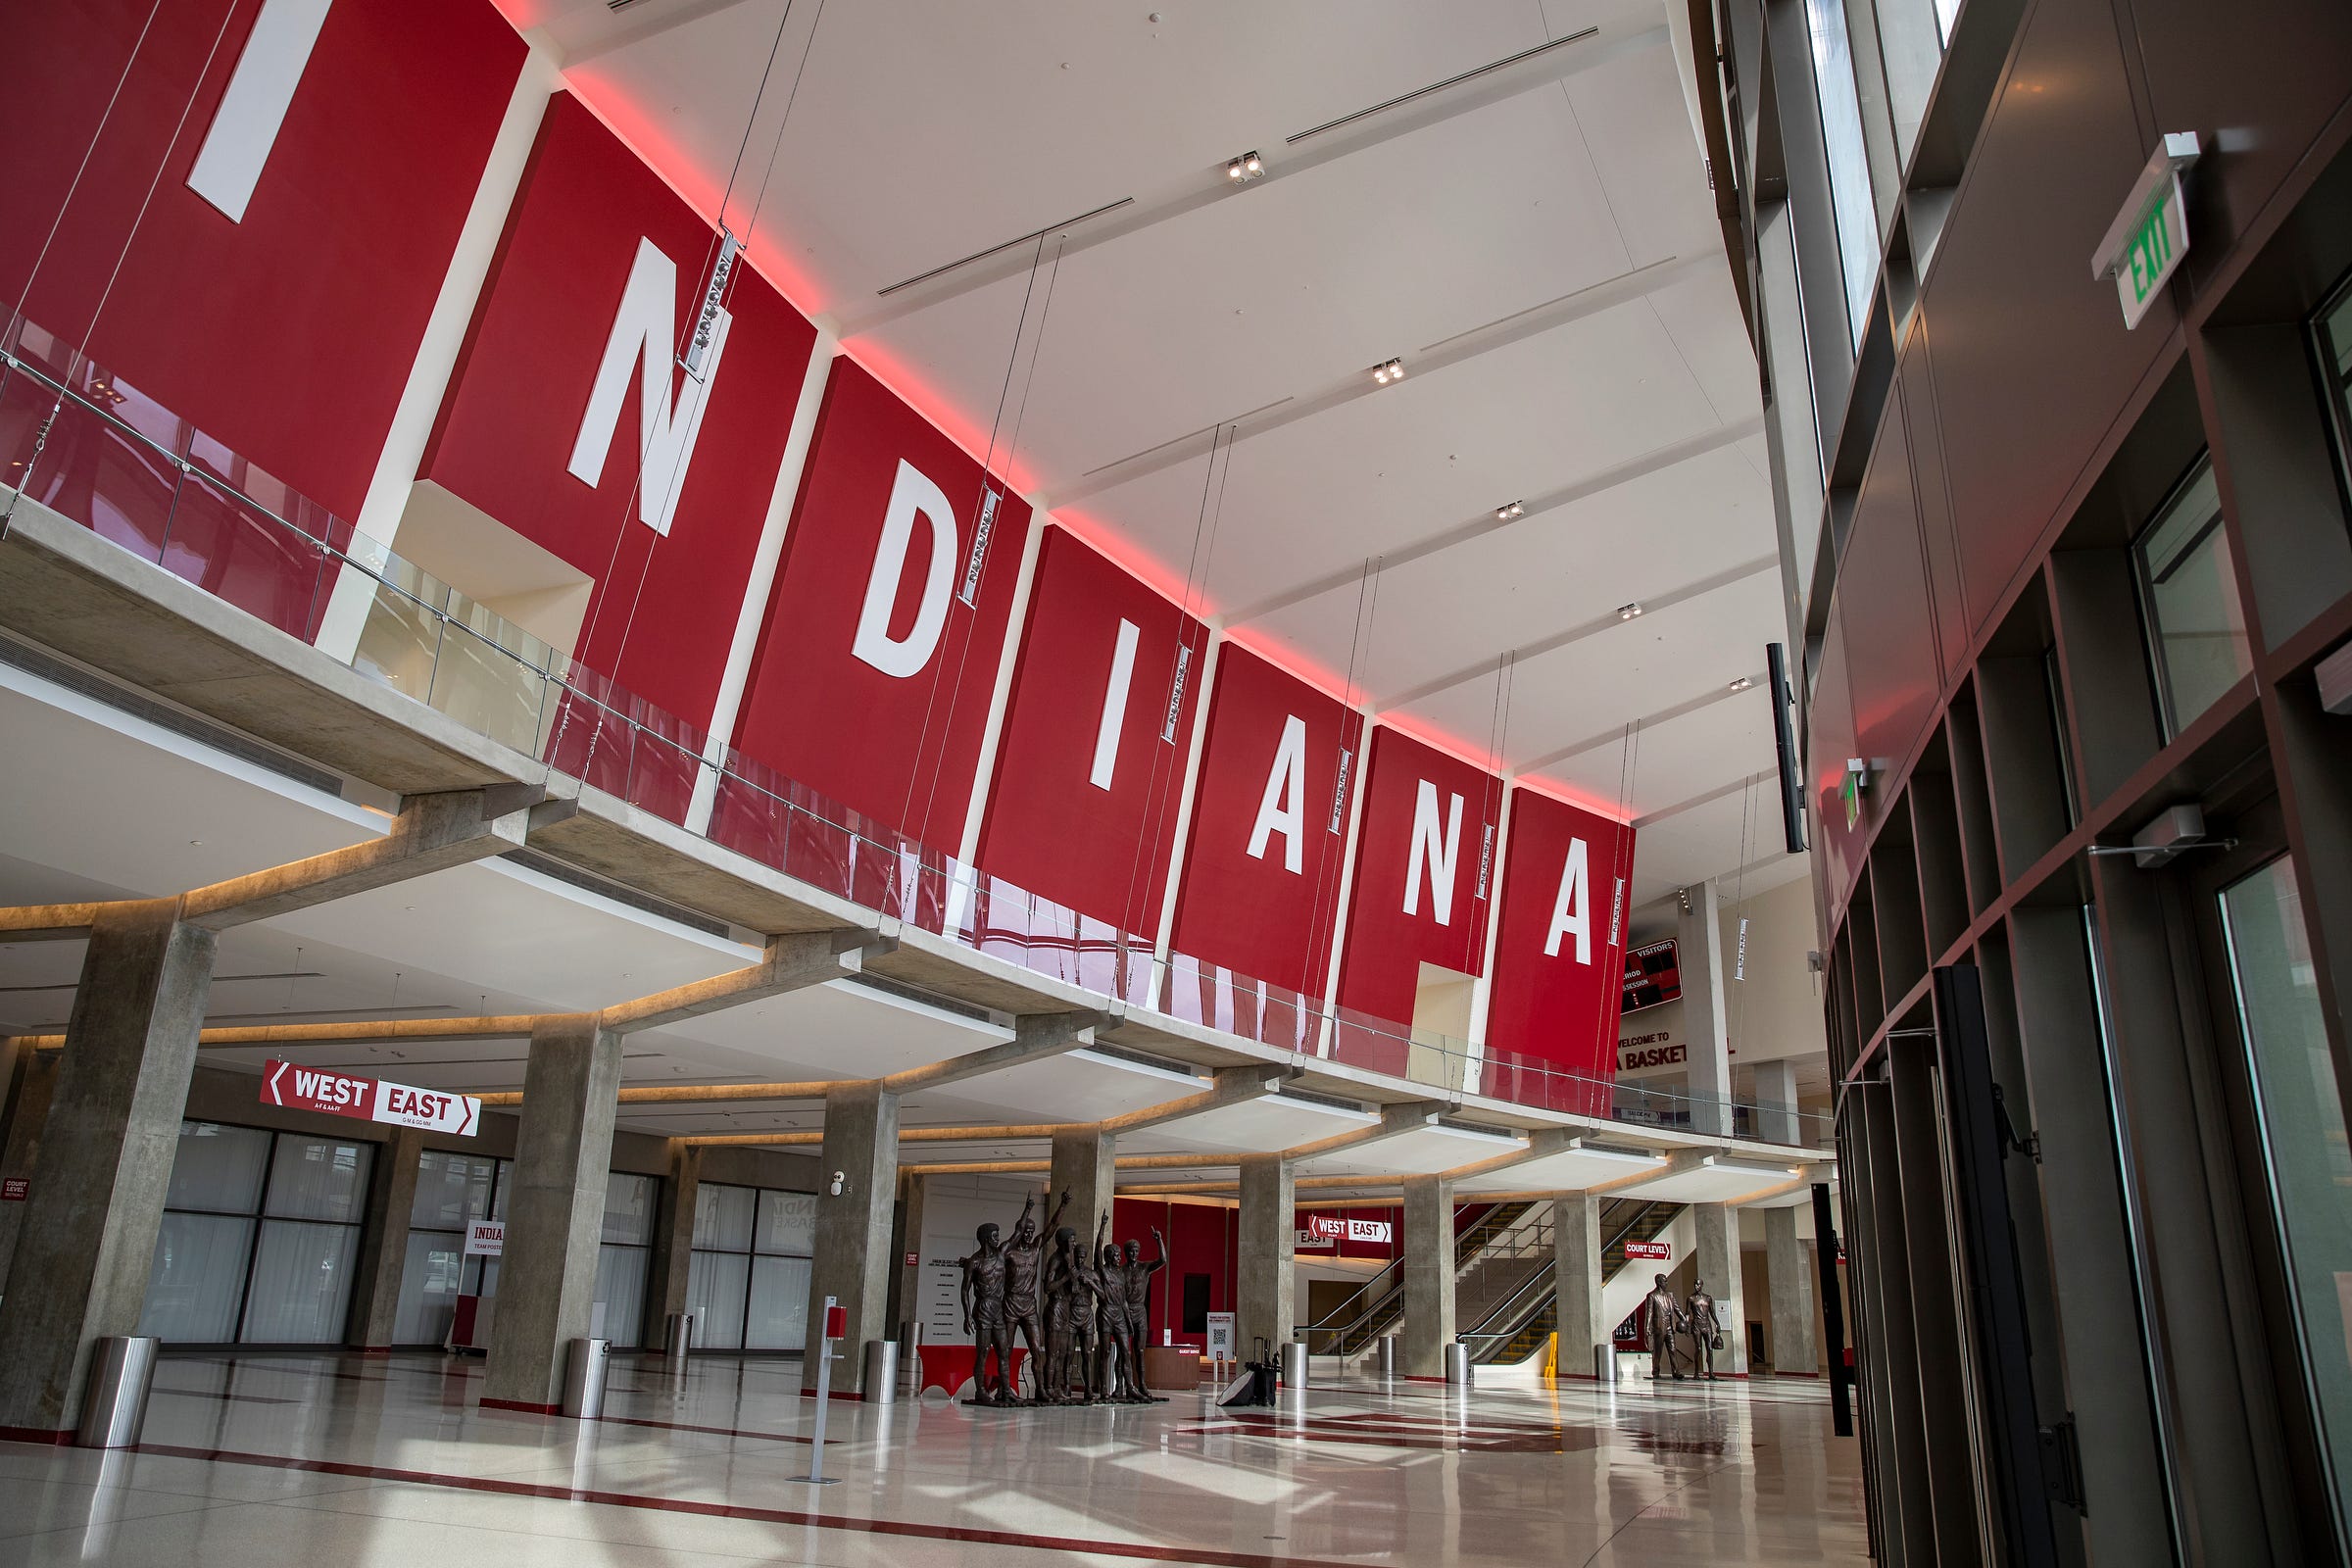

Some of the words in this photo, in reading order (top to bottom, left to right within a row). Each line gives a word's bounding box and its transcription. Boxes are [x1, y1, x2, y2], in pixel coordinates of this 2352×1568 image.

[2128, 196, 2172, 305] EXIT
[1637, 942, 1673, 957] VISITORS
[1623, 969, 1642, 980] RIOD
[1656, 1032, 1670, 1042] TO
[295, 1069, 368, 1107] WEST
[387, 1088, 452, 1120] EAST
[1318, 1218, 1346, 1234] WEST
[1353, 1222, 1379, 1236] EAST
[474, 1227, 503, 1241] INDIA
[1627, 1244, 1648, 1253] COURT
[1648, 1245, 1666, 1254] LEVEL
